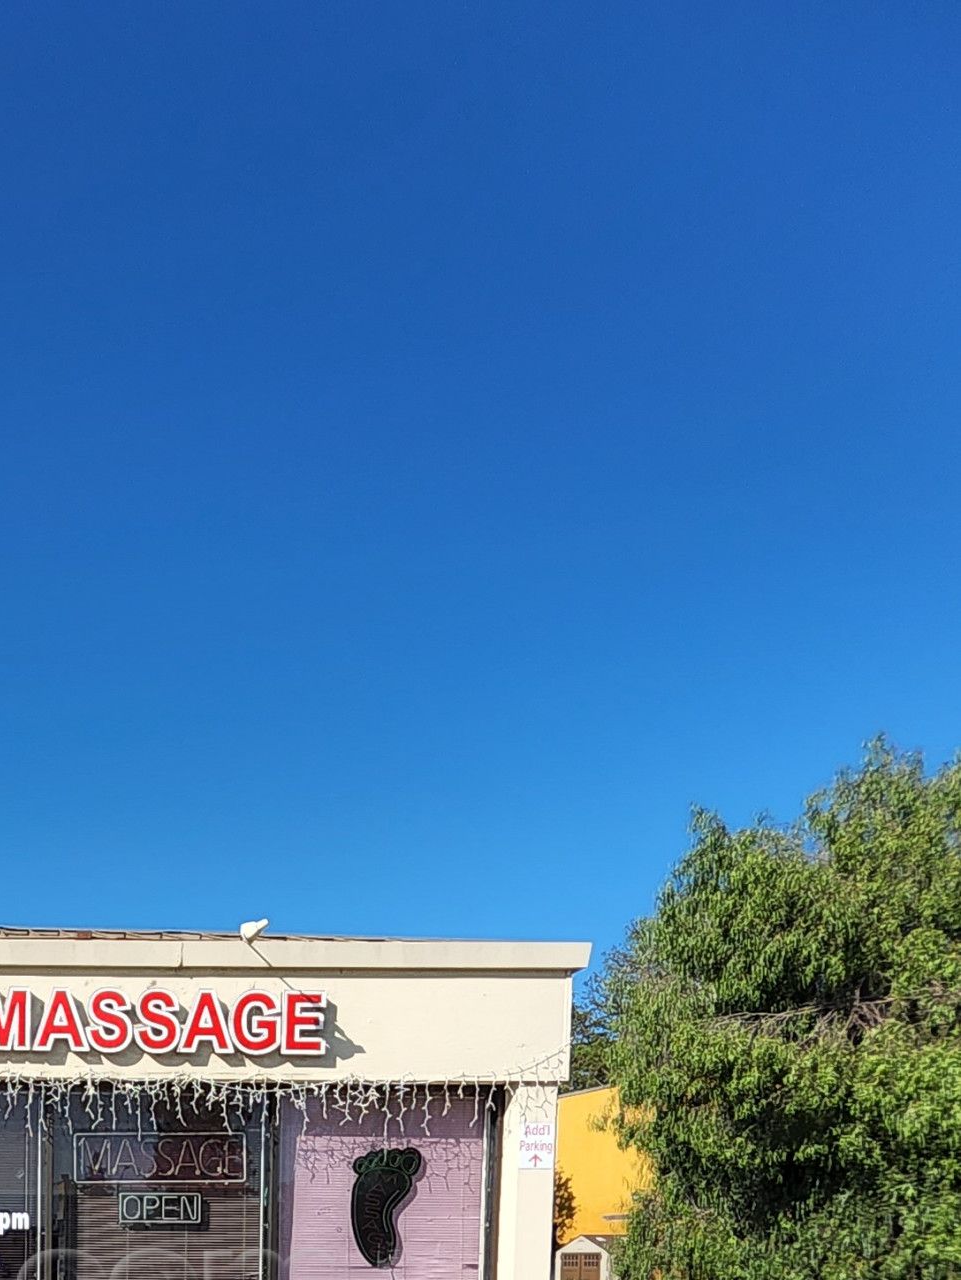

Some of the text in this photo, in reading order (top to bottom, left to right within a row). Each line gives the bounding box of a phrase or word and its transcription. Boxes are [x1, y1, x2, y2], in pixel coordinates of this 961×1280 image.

[79, 1137, 242, 1177] MASSAGE
[519, 1140, 553, 1154] Parking
[123, 1195, 197, 1220] OPEN
